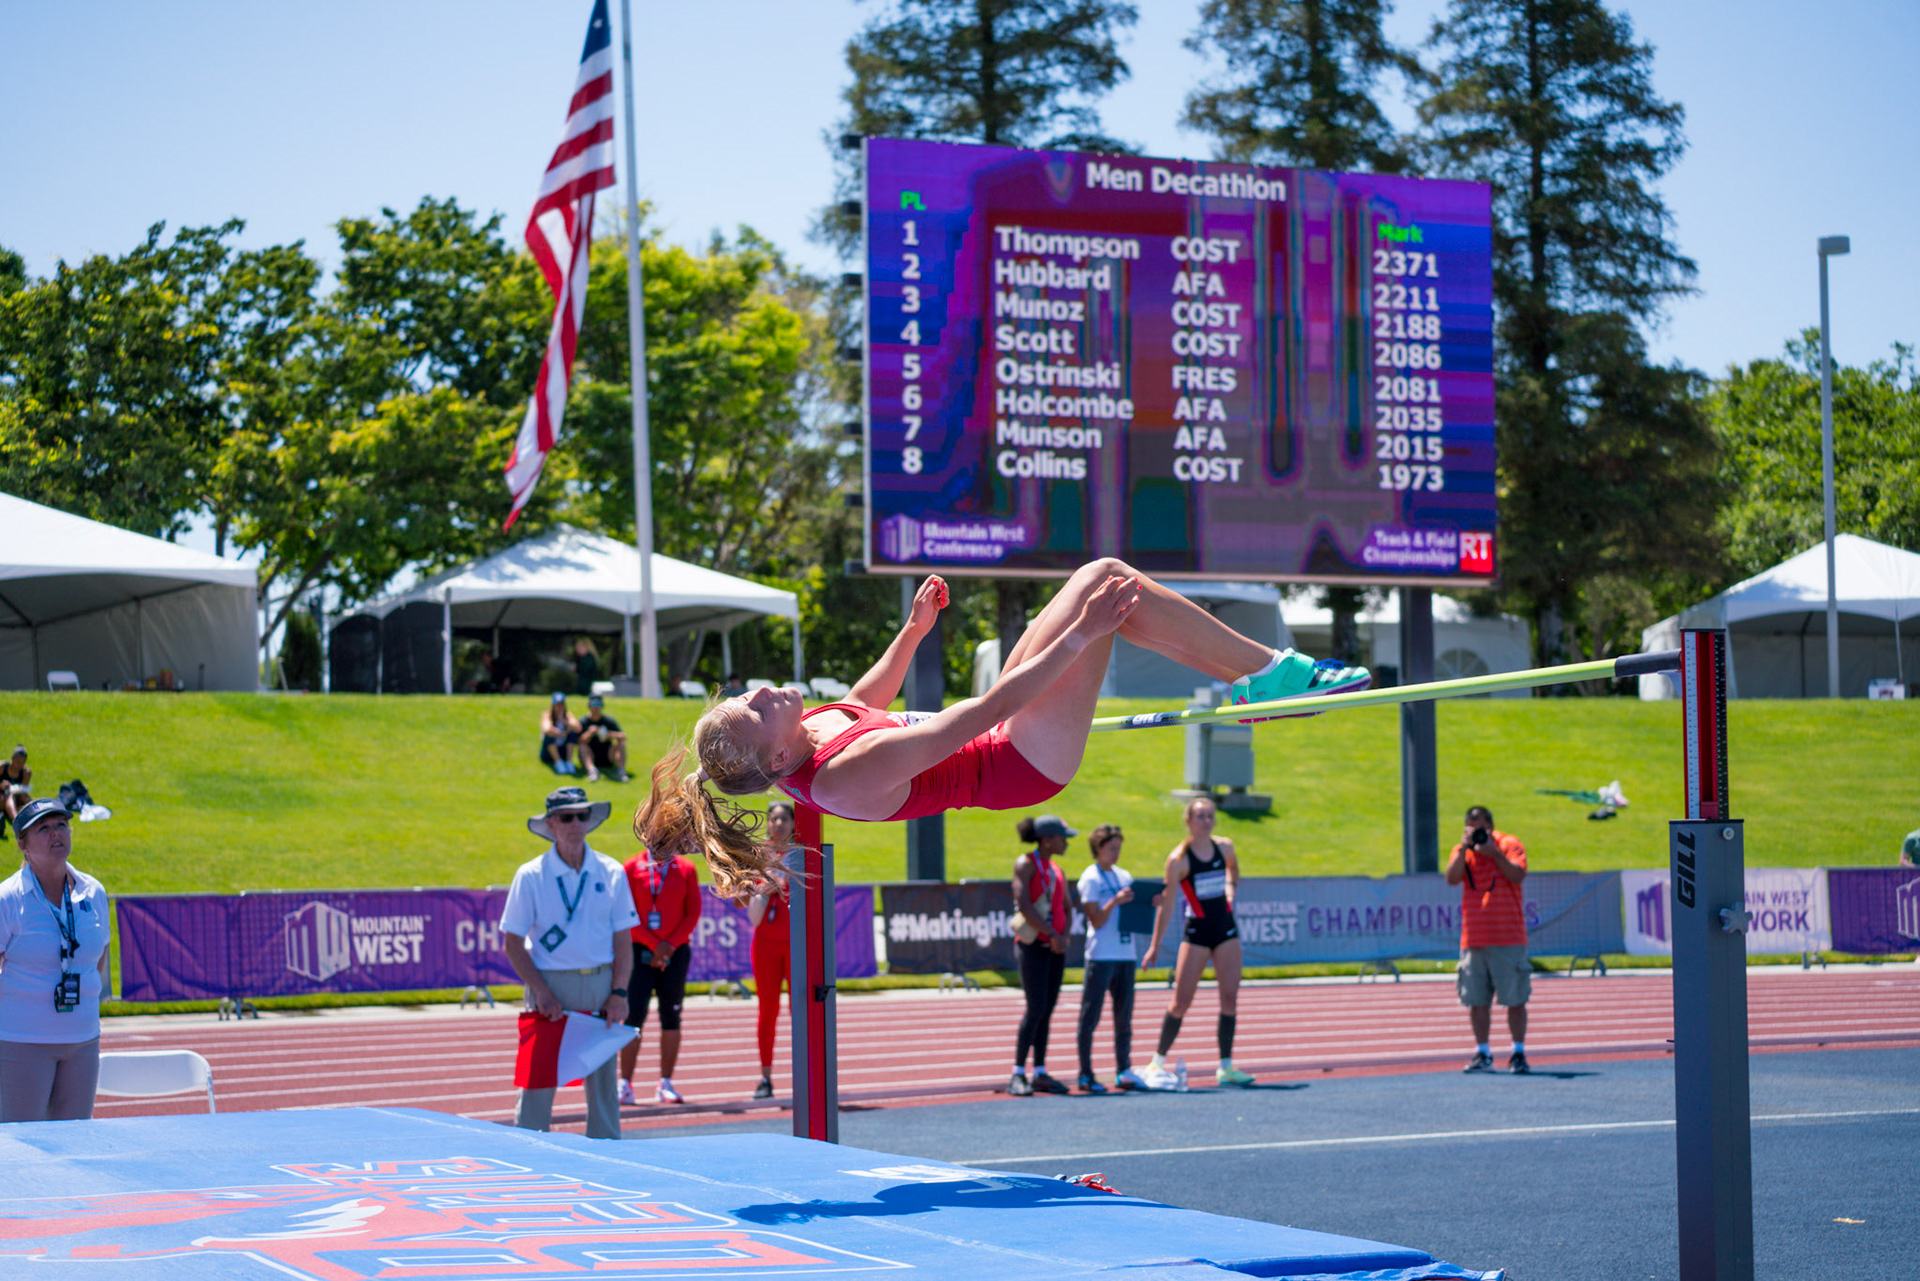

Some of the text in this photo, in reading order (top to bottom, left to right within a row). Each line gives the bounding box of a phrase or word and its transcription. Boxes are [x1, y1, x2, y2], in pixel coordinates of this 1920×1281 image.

[1088, 163, 1286, 200] Men Decathlon
[900, 191, 926, 211] PL
[902, 220, 1437, 276] 1 Thompson COST 2371
[903, 254, 1438, 310] 2 Hubbard AFA 2211
[903, 286, 1440, 339] 3 Munoz COST 2188
[902, 321, 1441, 368] 4 Scott COST 2086
[904, 355, 1440, 402] 5 Ostrinski FRES 2081
[904, 385, 1441, 431] 6 Holcombe AFA 2035
[904, 416, 1442, 460] 7 Munson AFA 2015
[903, 448, 1443, 490] 8 Collins COST 1973
[923, 522, 1025, 541] Mountain West
[1460, 533, 1491, 560] RT
[1677, 831, 1695, 909] GILL
[1235, 902, 1298, 917] MOUNTAIN
[1771, 889, 1810, 906] WEST
[352, 915, 424, 934] MOUNTAIN
[889, 908, 1086, 948] #MakingHk
[1237, 916, 1299, 943] WEST
[1307, 901, 1540, 936] CHAMPIONS
[353, 933, 424, 965] WEST
